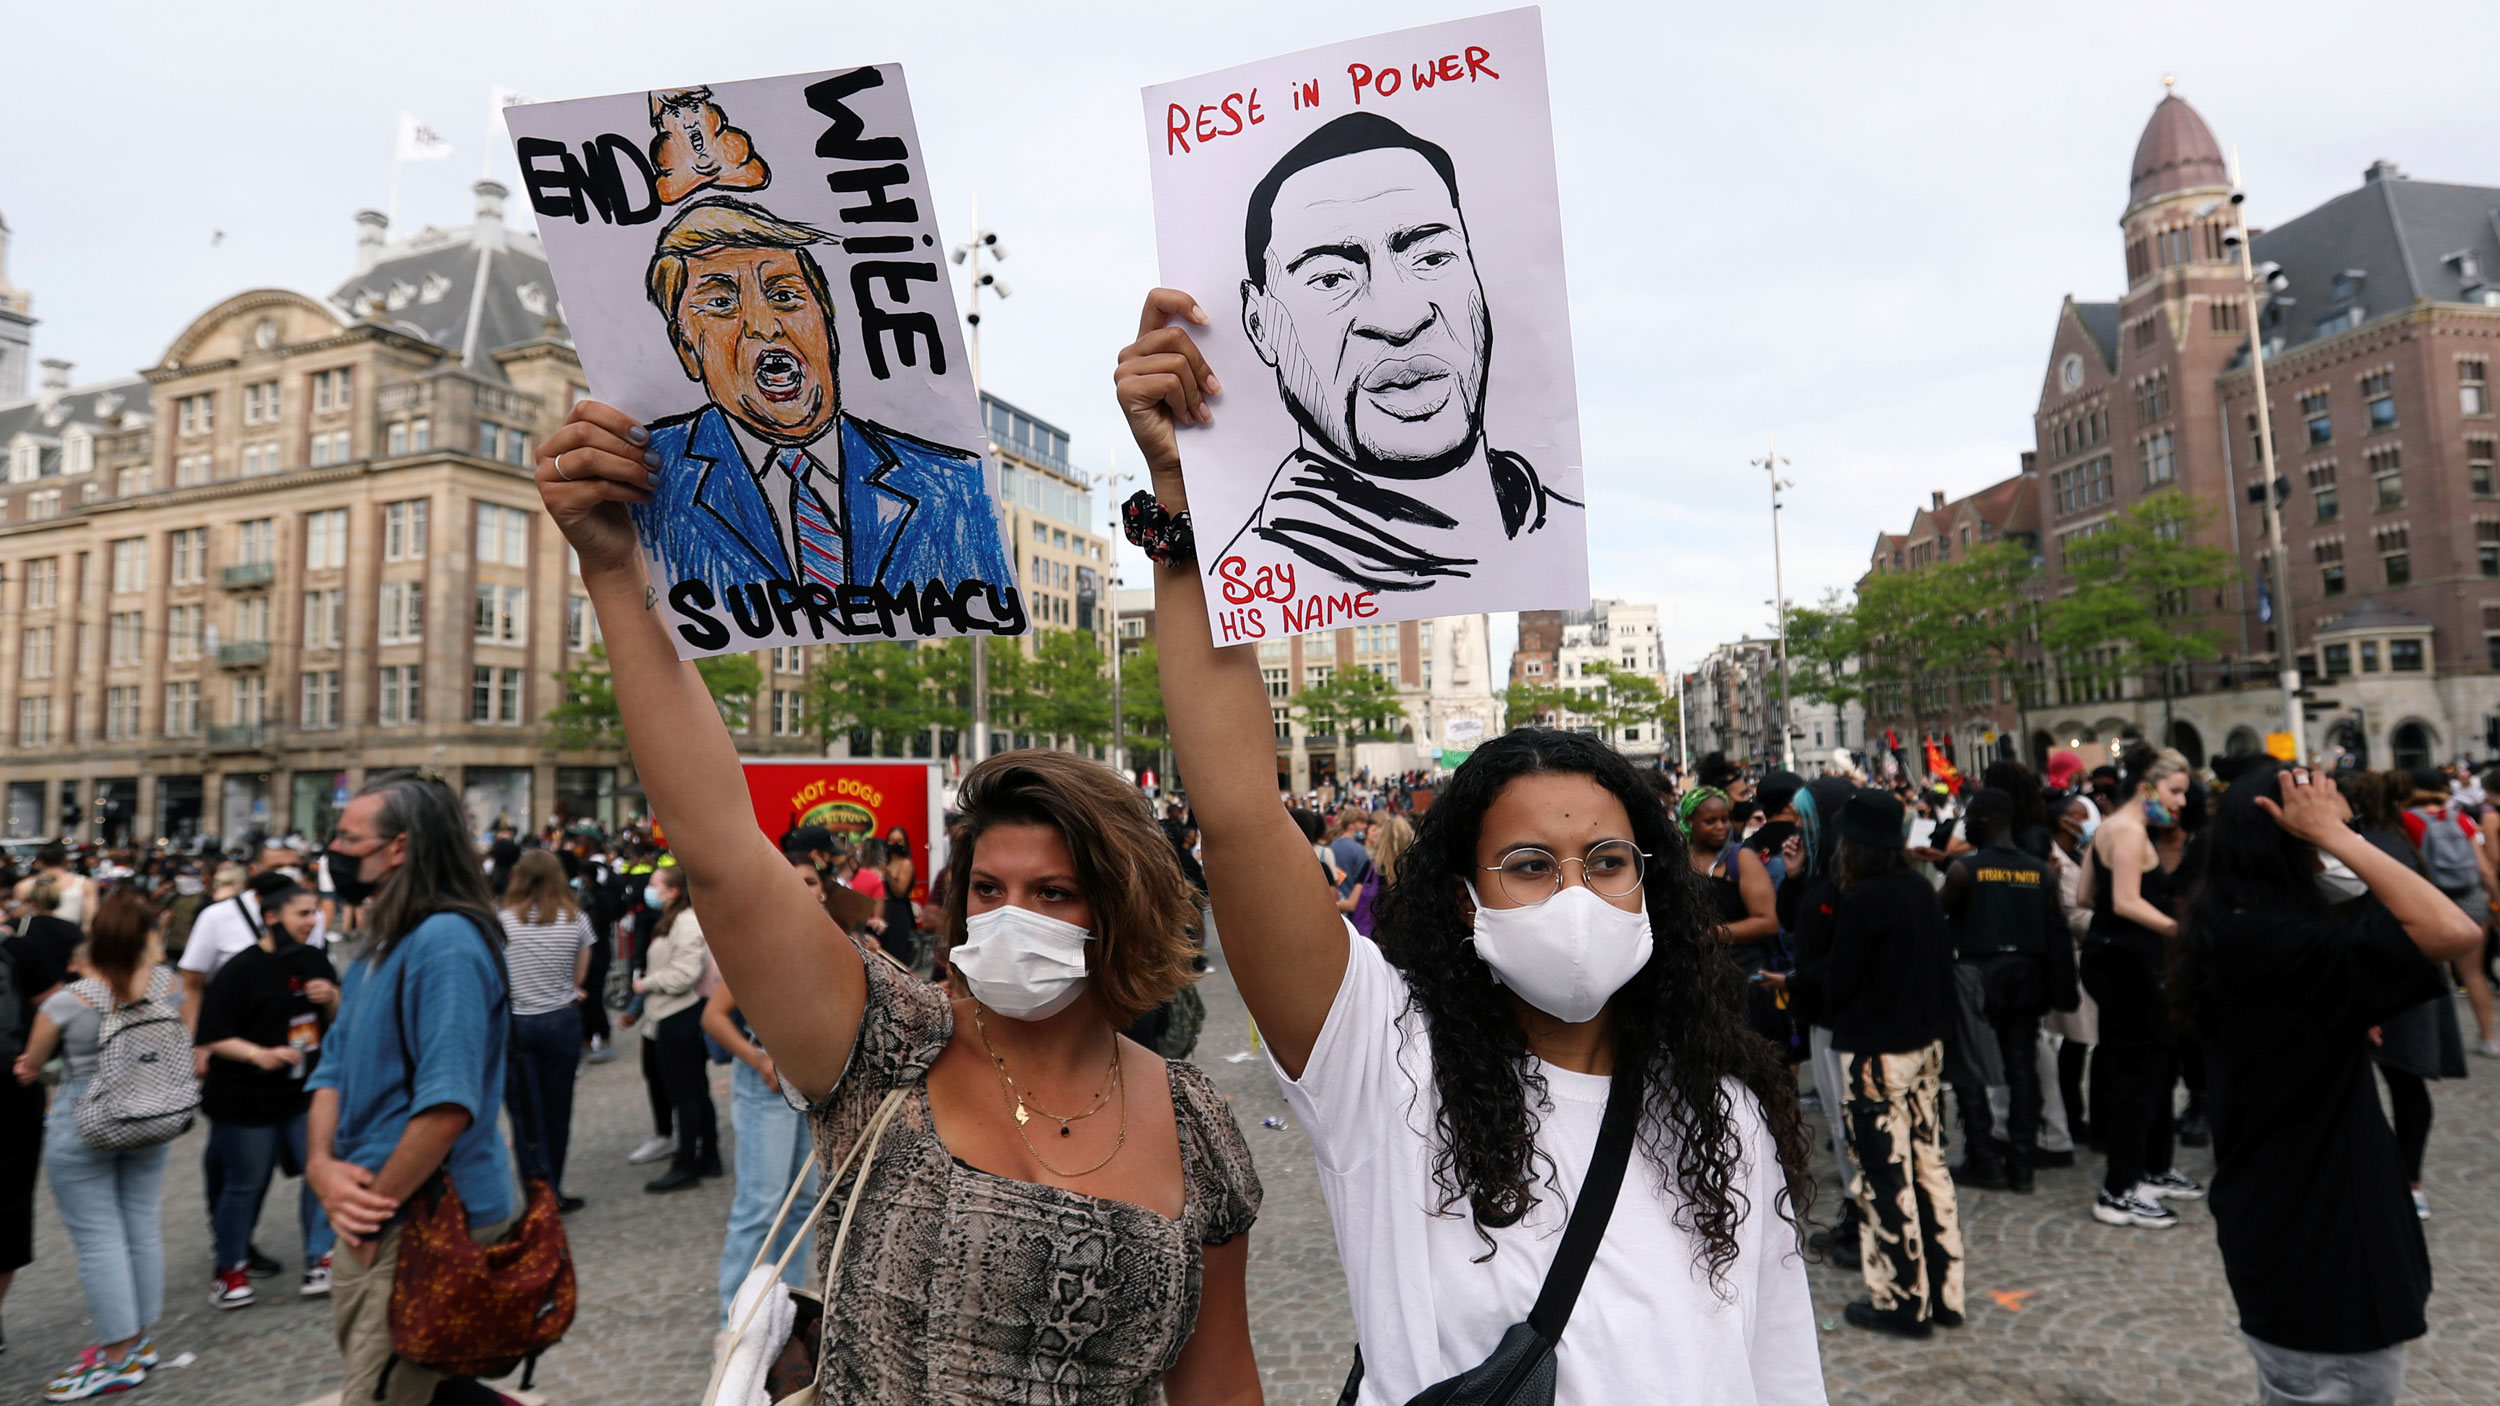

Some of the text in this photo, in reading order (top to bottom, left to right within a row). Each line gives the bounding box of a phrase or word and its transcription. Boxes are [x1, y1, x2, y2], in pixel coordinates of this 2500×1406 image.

[1347, 45, 1500, 104] POWER
[517, 133, 662, 225] END
[1219, 556, 1296, 605] Say
[668, 577, 1032, 651] SUPREMACY
[1282, 591, 1379, 633] NAME
